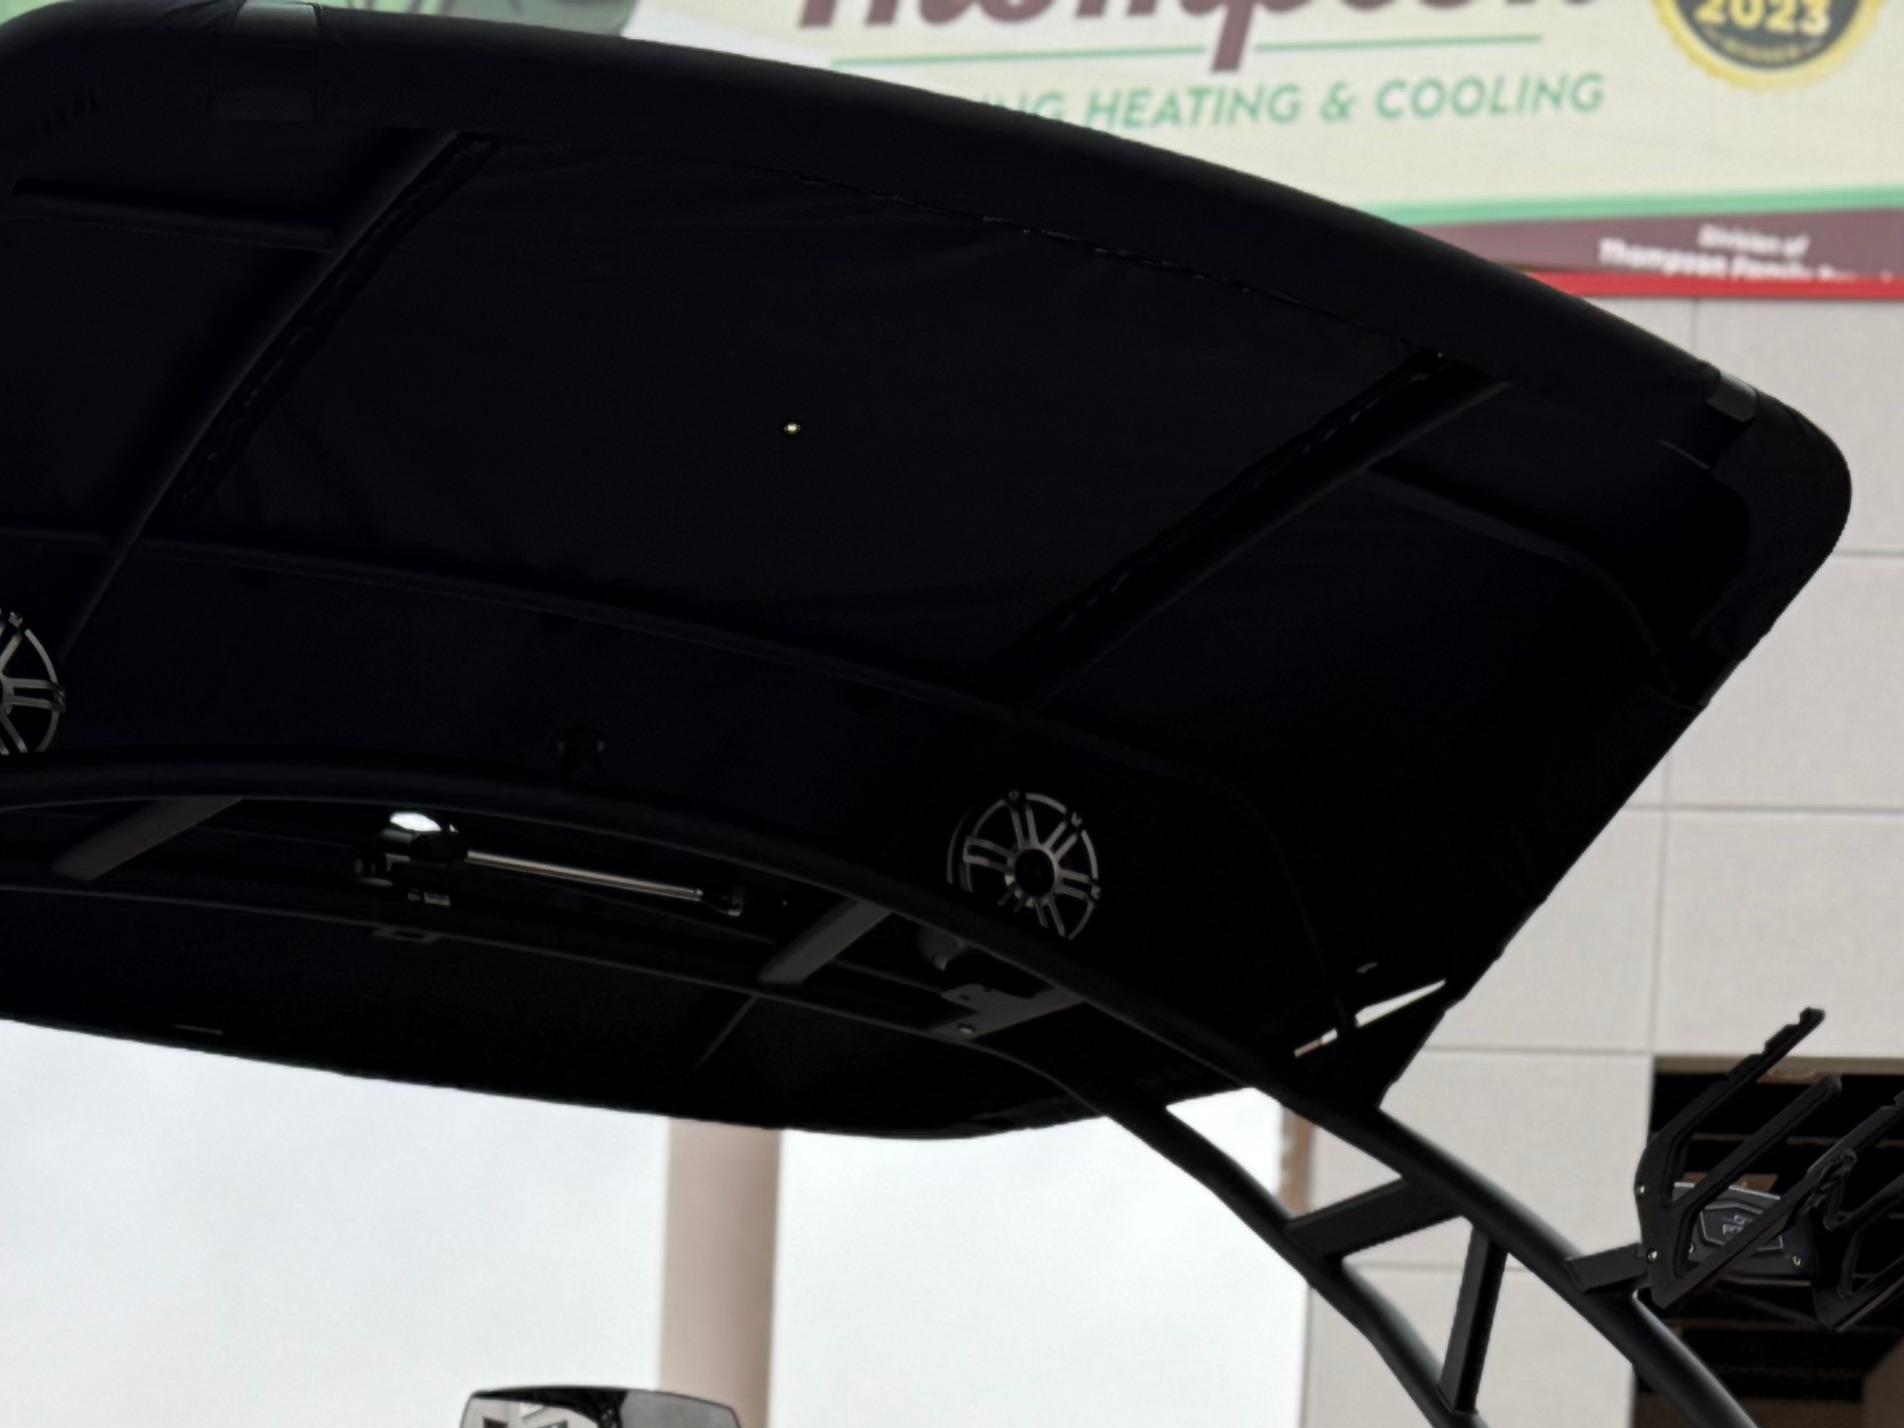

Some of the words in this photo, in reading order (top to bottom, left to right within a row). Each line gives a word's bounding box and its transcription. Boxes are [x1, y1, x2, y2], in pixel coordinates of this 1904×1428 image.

[1086, 84, 1302, 131] HEATING
[1320, 80, 1355, 122] &
[1376, 71, 1606, 120] COOLING
